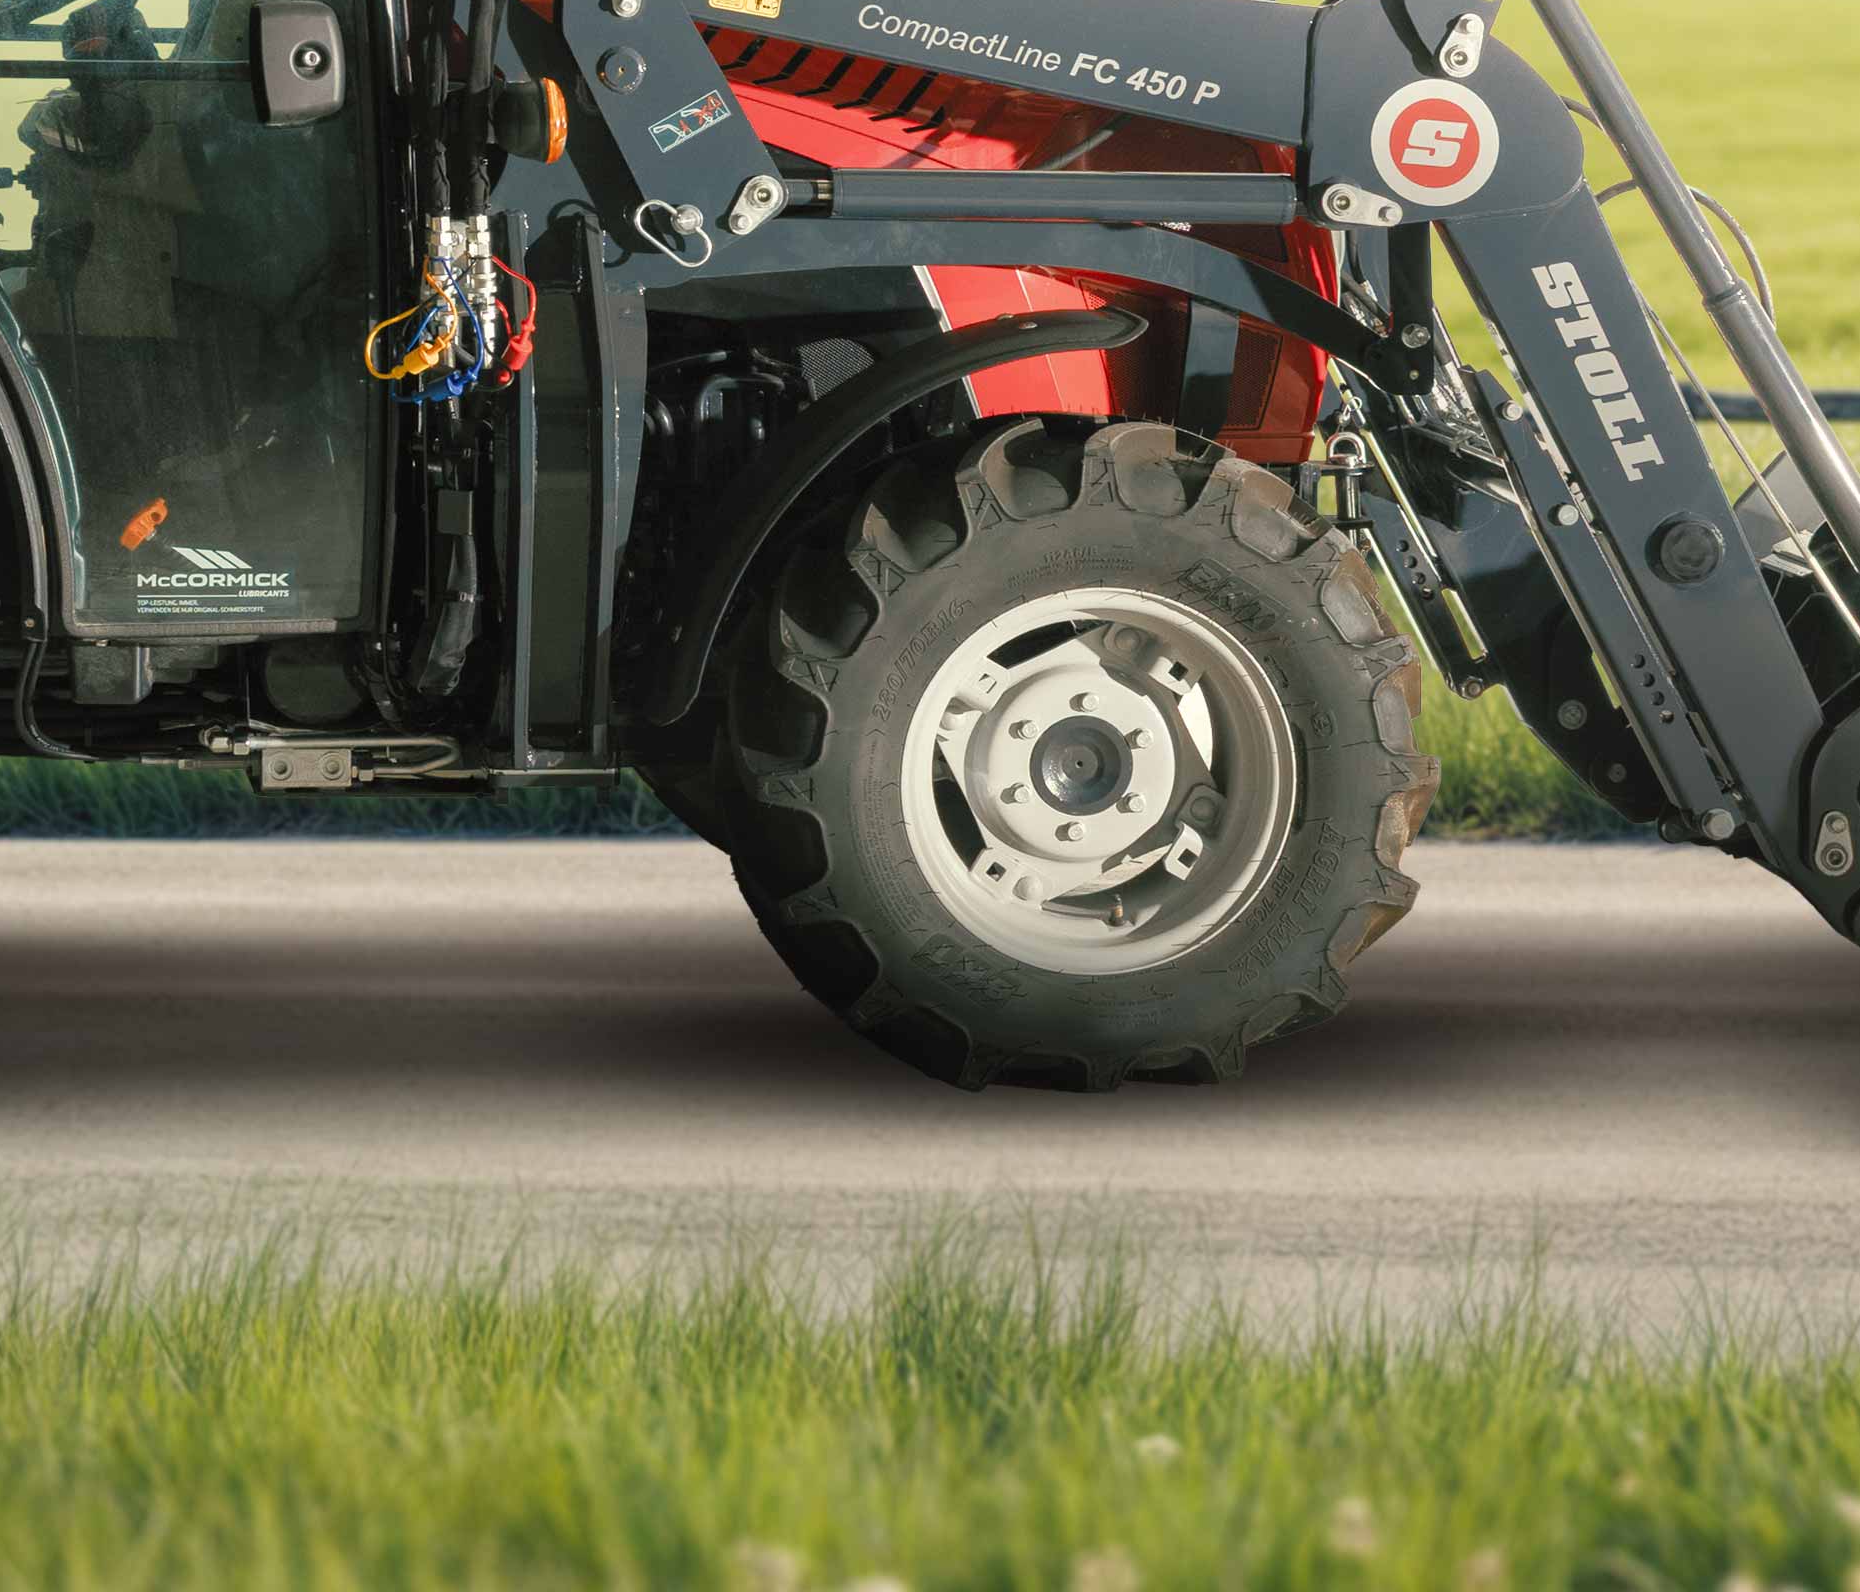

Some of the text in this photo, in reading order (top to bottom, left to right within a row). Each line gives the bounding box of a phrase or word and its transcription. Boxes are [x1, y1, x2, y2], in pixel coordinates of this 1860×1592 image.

[857, 3, 1221, 105] CompactLine FC 450 P
[1402, 119, 1469, 168] S
[1530, 261, 1665, 482] STOLL
[136, 572, 290, 588] McCORMICK
[238, 589, 290, 598] LUBRICANTS
[1227, 822, 1347, 988] AGRI MAX
